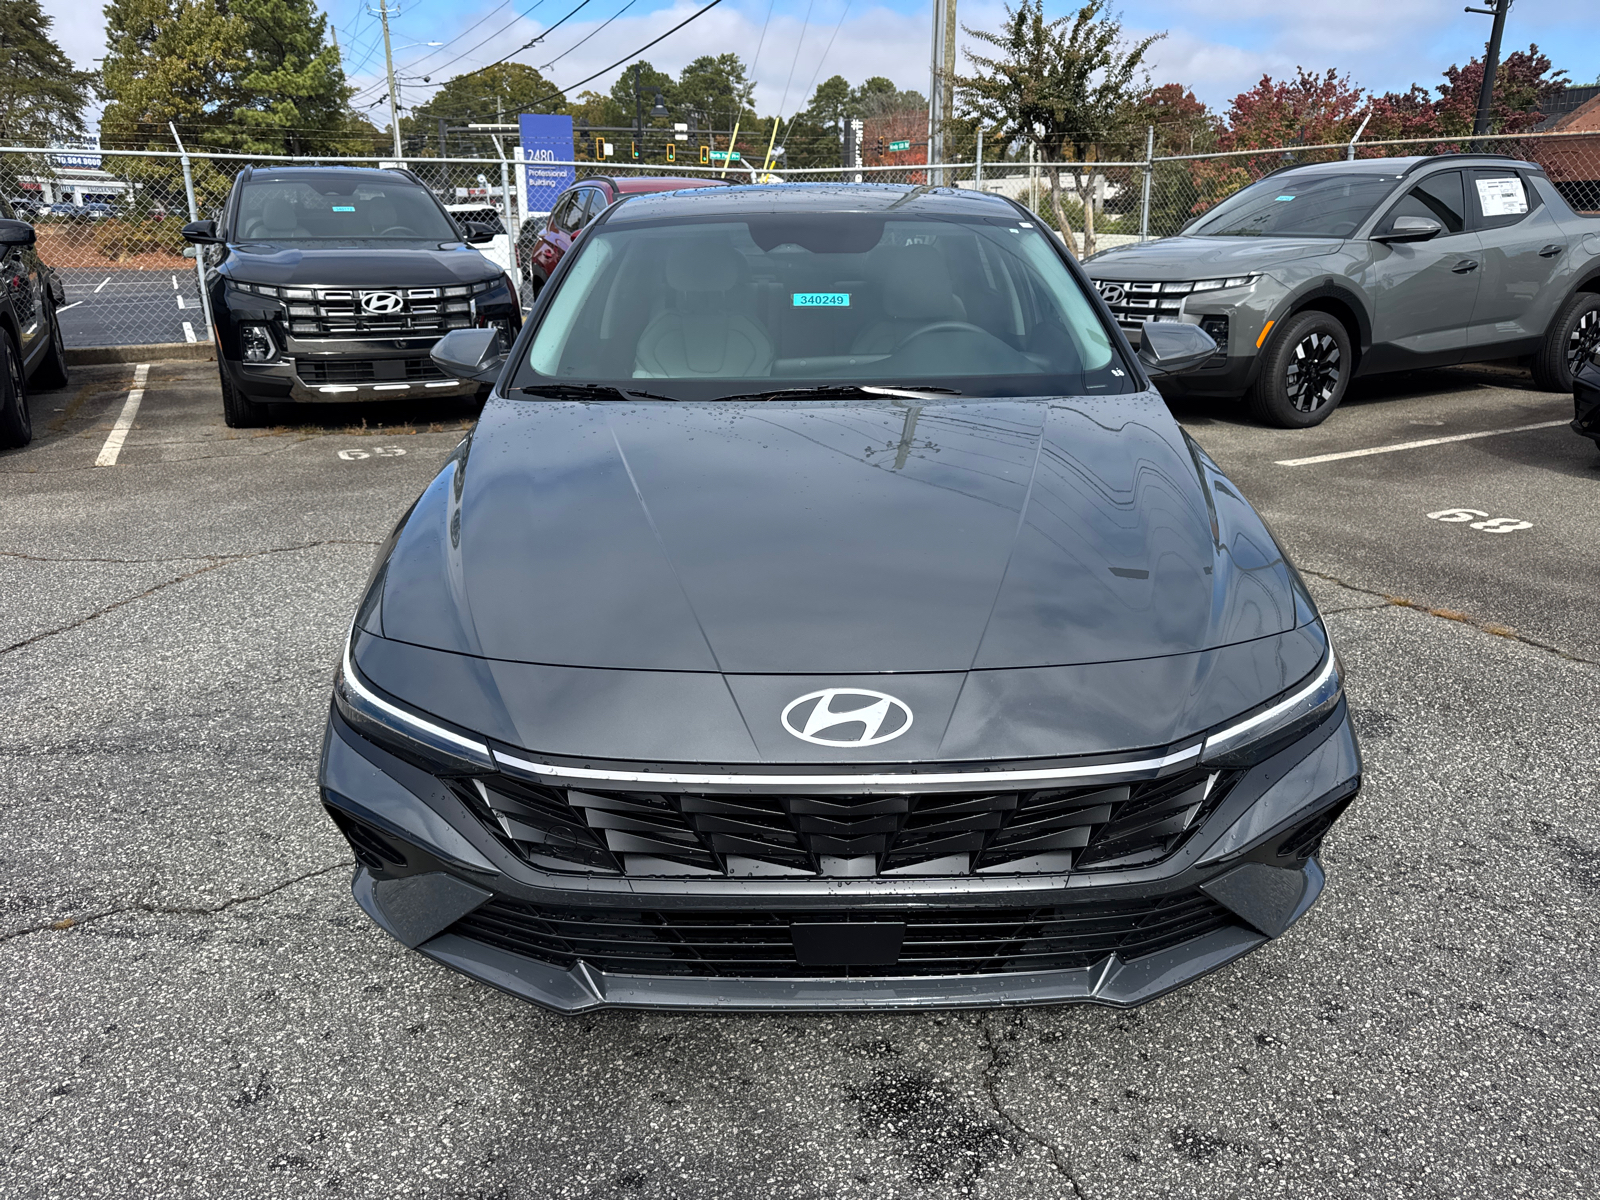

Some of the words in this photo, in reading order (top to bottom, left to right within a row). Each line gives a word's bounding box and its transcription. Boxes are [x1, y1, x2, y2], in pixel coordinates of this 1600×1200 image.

[527, 149, 554, 162] 2480
[528, 169, 568, 177] Professional
[528, 178, 556, 188] Building
[800, 295, 844, 305] 340249
[337, 445, 407, 461] 65
[1426, 508, 1534, 534] 68
